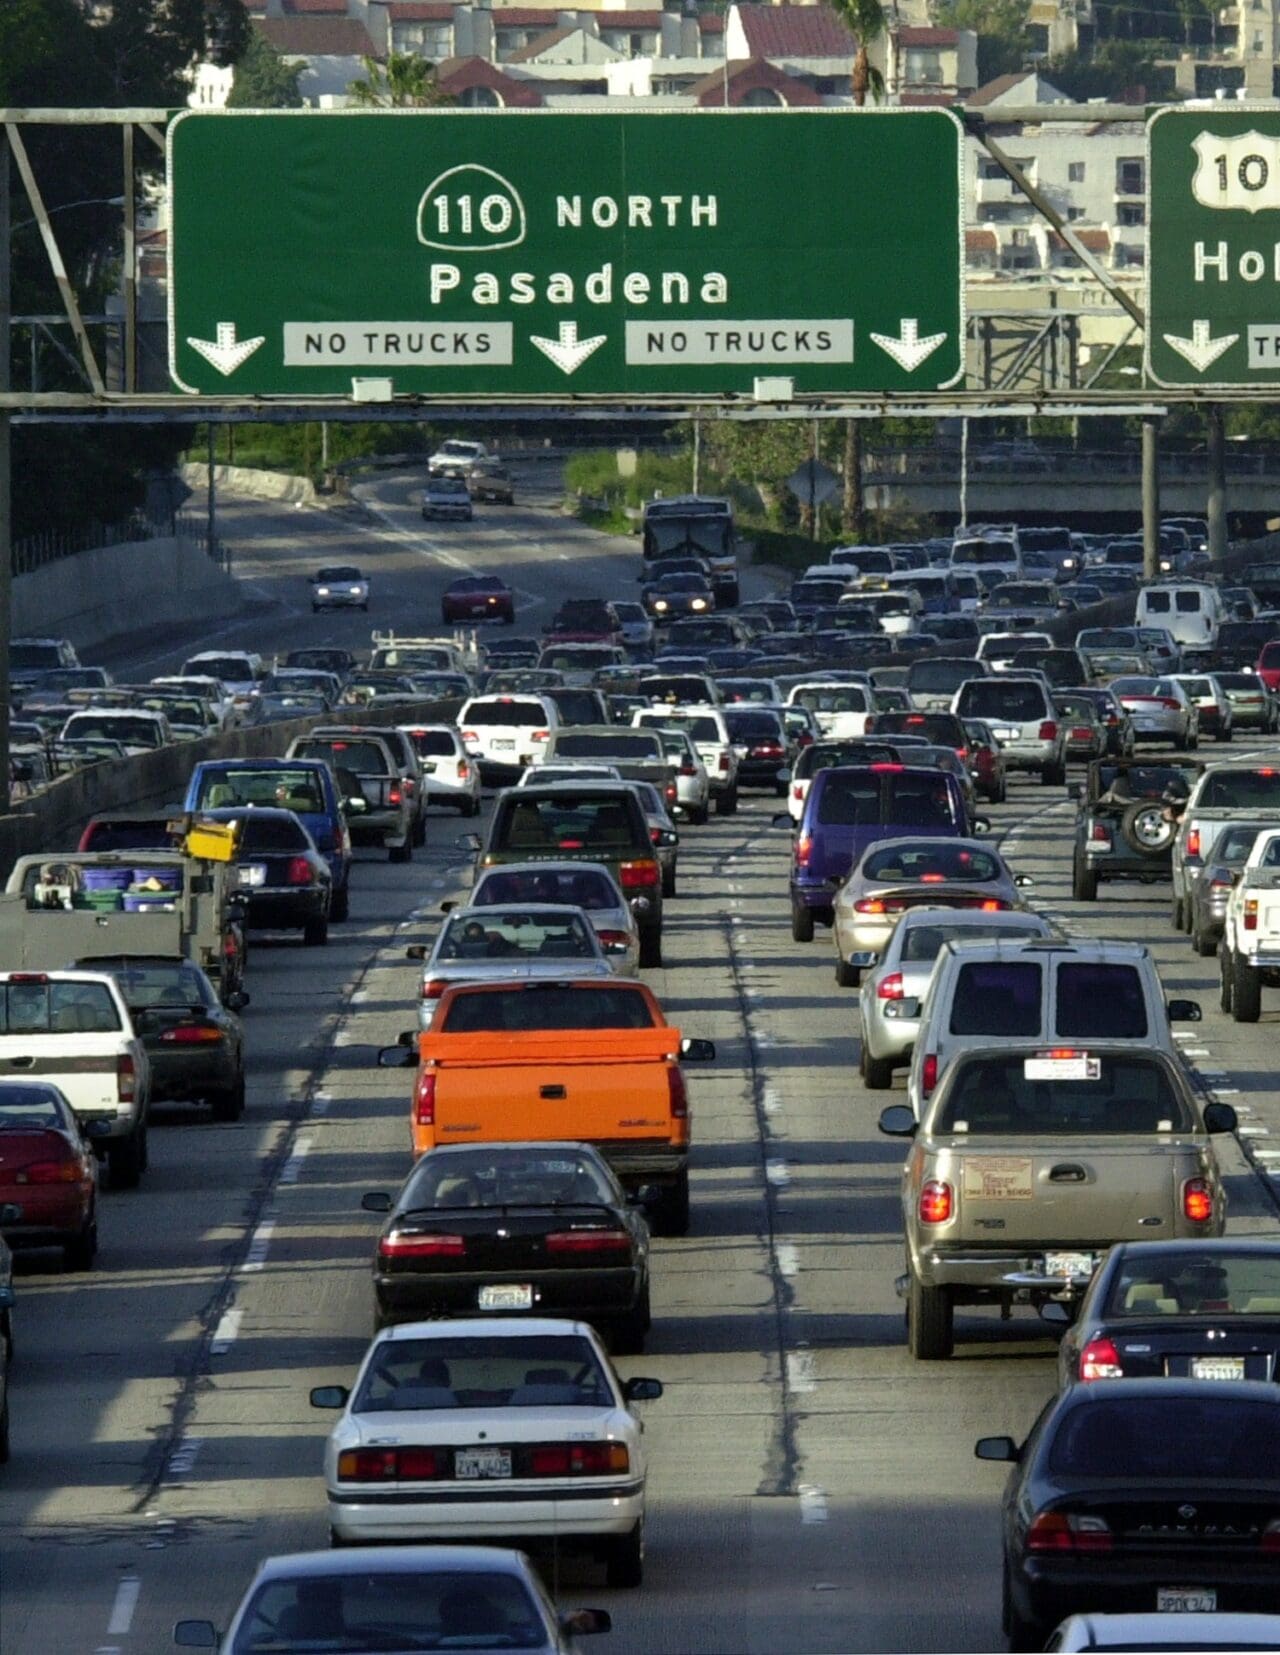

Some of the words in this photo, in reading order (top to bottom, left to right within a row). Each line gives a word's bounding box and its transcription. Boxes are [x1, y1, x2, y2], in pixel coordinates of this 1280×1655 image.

[433, 194, 512, 234] 110
[557, 195, 716, 227] NORTH
[431, 263, 727, 304] Pasadena
[306, 333, 345, 353] NO
[364, 333, 490, 353] TRUCKS
[648, 332, 687, 352] NO
[705, 331, 831, 351] TRUCKS
